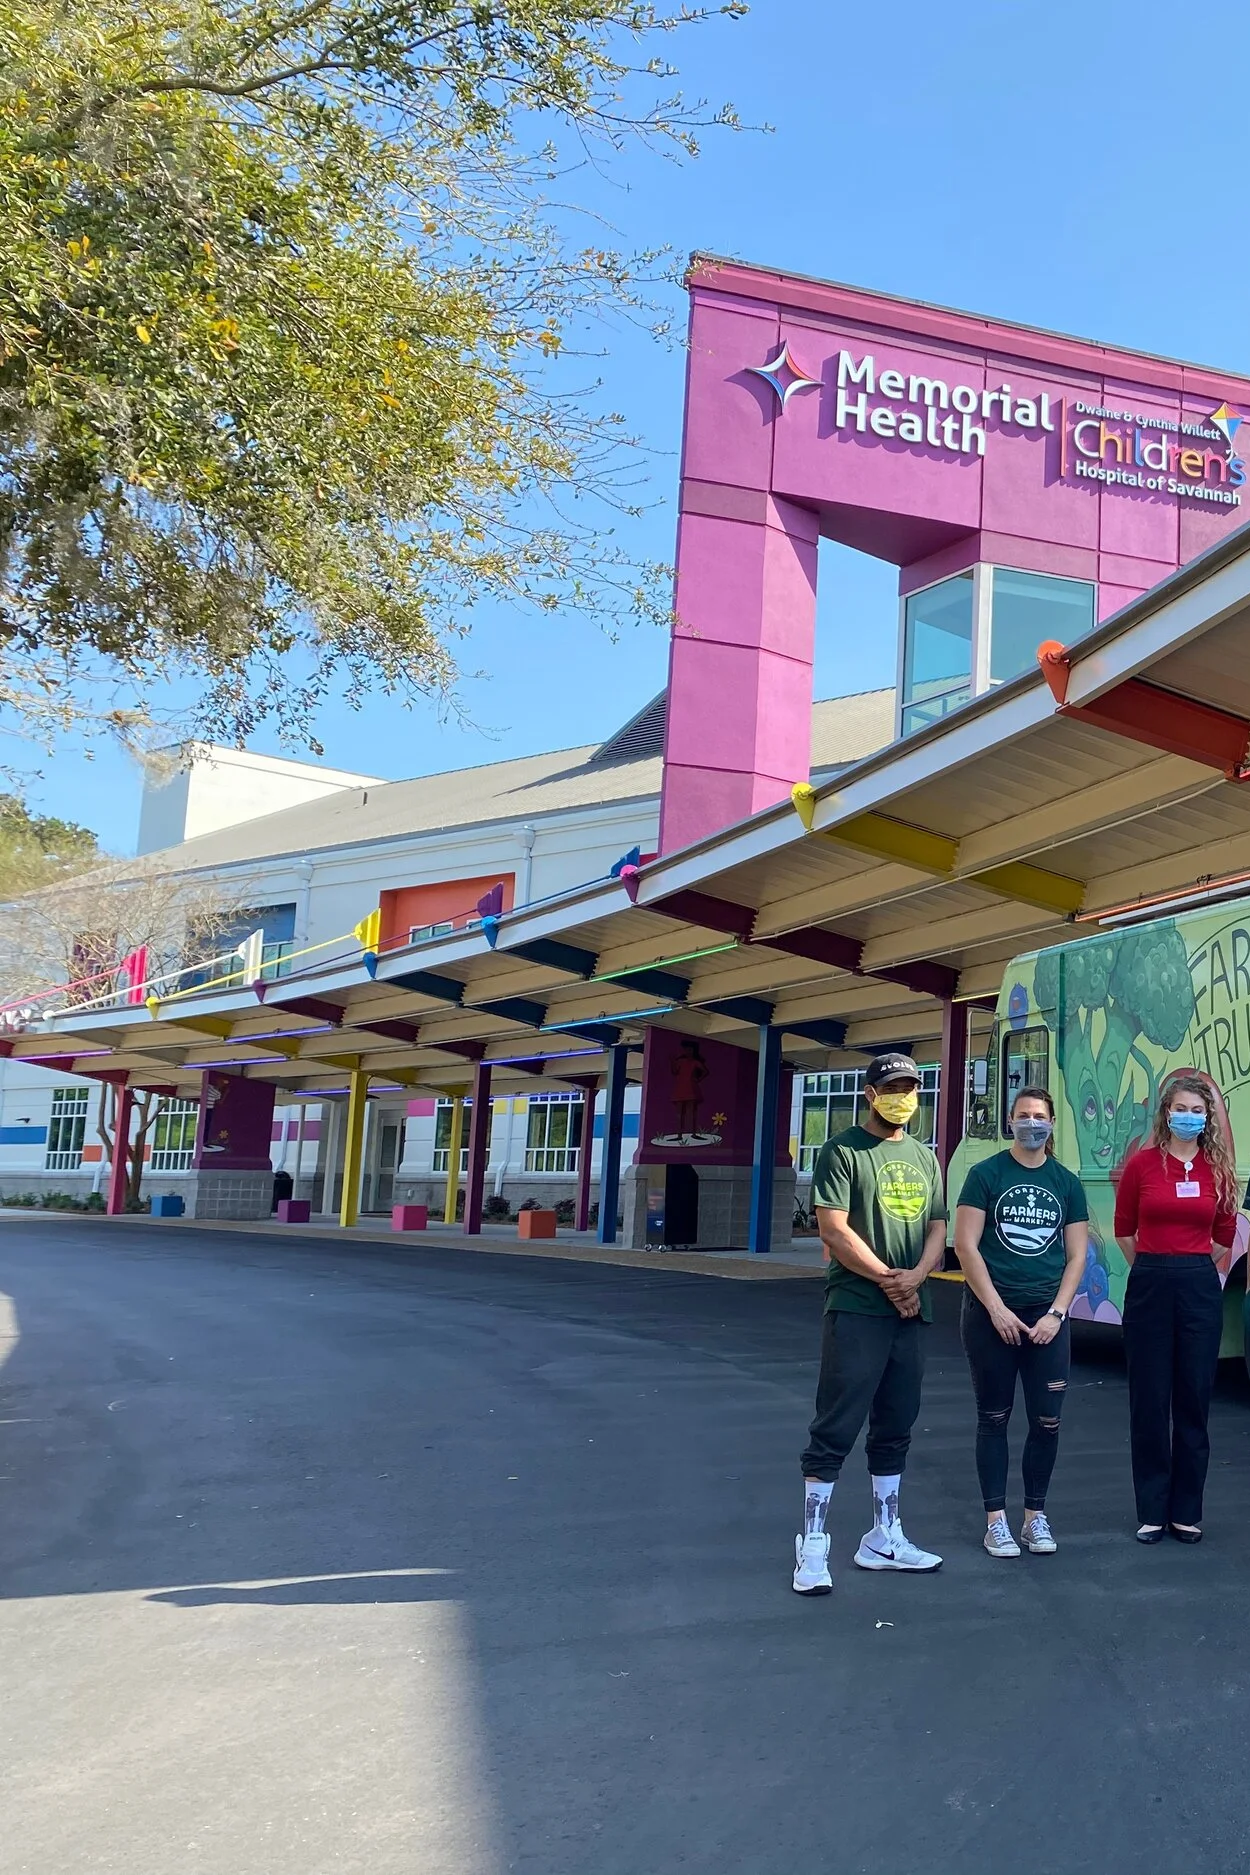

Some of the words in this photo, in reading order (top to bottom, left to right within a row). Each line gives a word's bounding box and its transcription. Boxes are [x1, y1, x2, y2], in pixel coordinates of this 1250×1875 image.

[837, 350, 1055, 431] Memorial
[836, 388, 986, 456] Health
[1076, 401, 1121, 421] Dwaine
[1124, 411, 1133, 422] &
[1136, 415, 1179, 432] Cynthia
[1181, 422, 1221, 441] Willett
[1076, 460, 1144, 487] Hospital
[1147, 475, 1165, 490] of
[1168, 478, 1241, 506] Savannah
[1008, 1187, 1053, 1203] FORSYTH
[1014, 1216, 1044, 1225] MARKET
